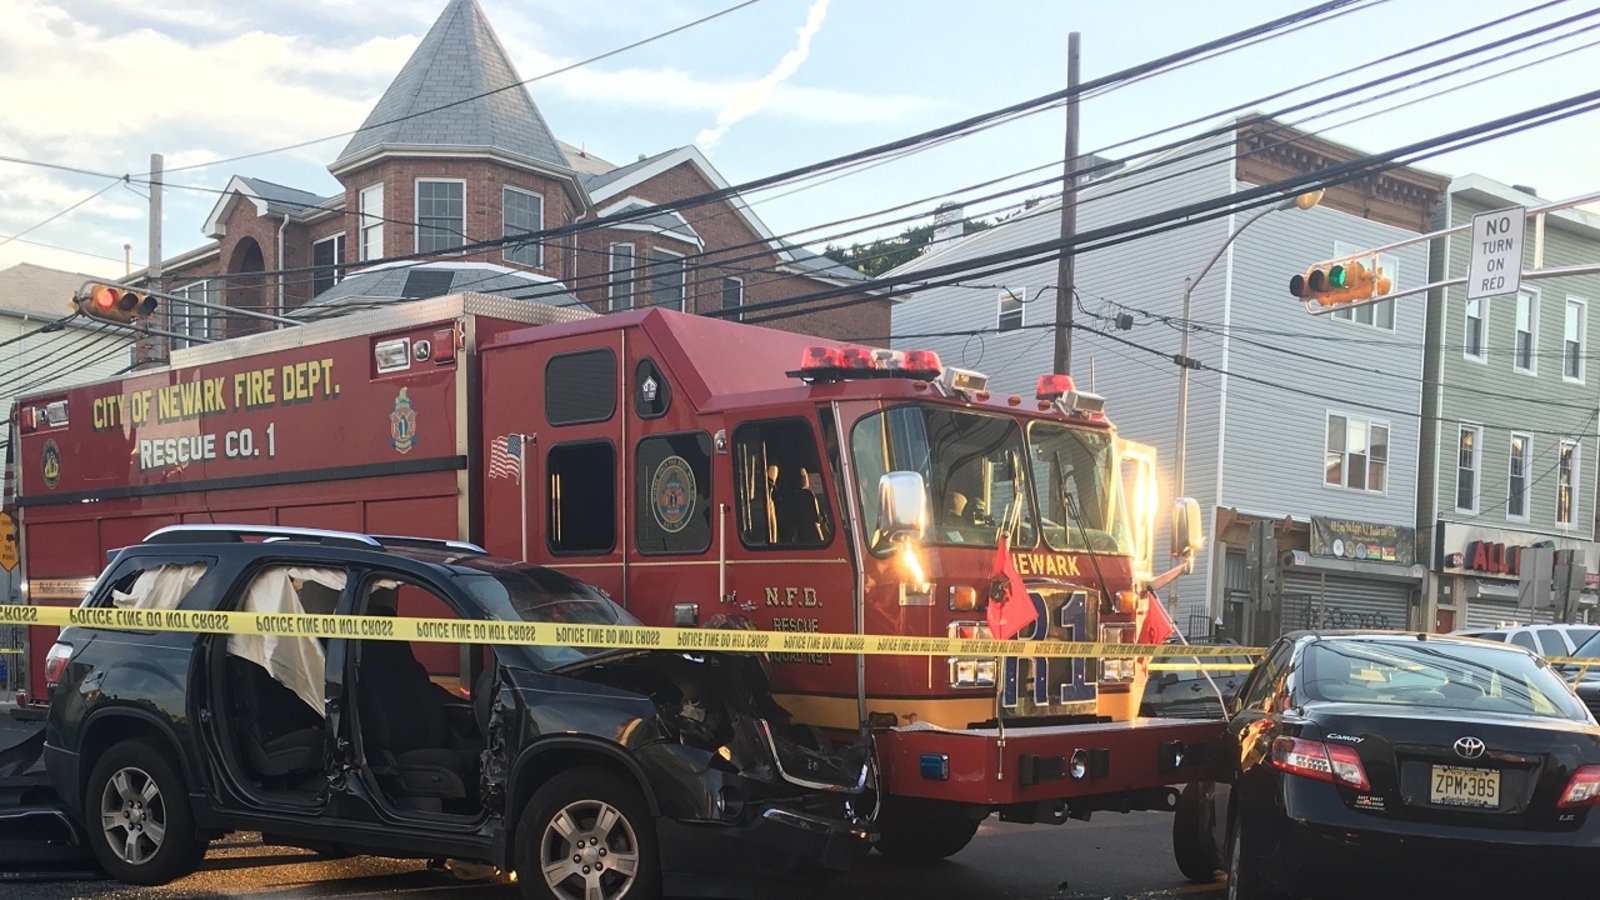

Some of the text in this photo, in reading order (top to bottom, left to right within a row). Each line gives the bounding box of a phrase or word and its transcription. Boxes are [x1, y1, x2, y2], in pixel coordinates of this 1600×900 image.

[1486, 217, 1511, 236] NO
[1482, 237, 1514, 255] TURN
[1487, 257, 1505, 272] ON
[1481, 276, 1505, 292] RED
[93, 358, 340, 431] CITY OF NEWARK FIRE DEPT.
[139, 422, 276, 471] RESCUE CO. 1
[1473, 540, 1510, 573] ALL
[765, 587, 823, 607] N.F.D.
[773, 618, 819, 633] RESCUE
